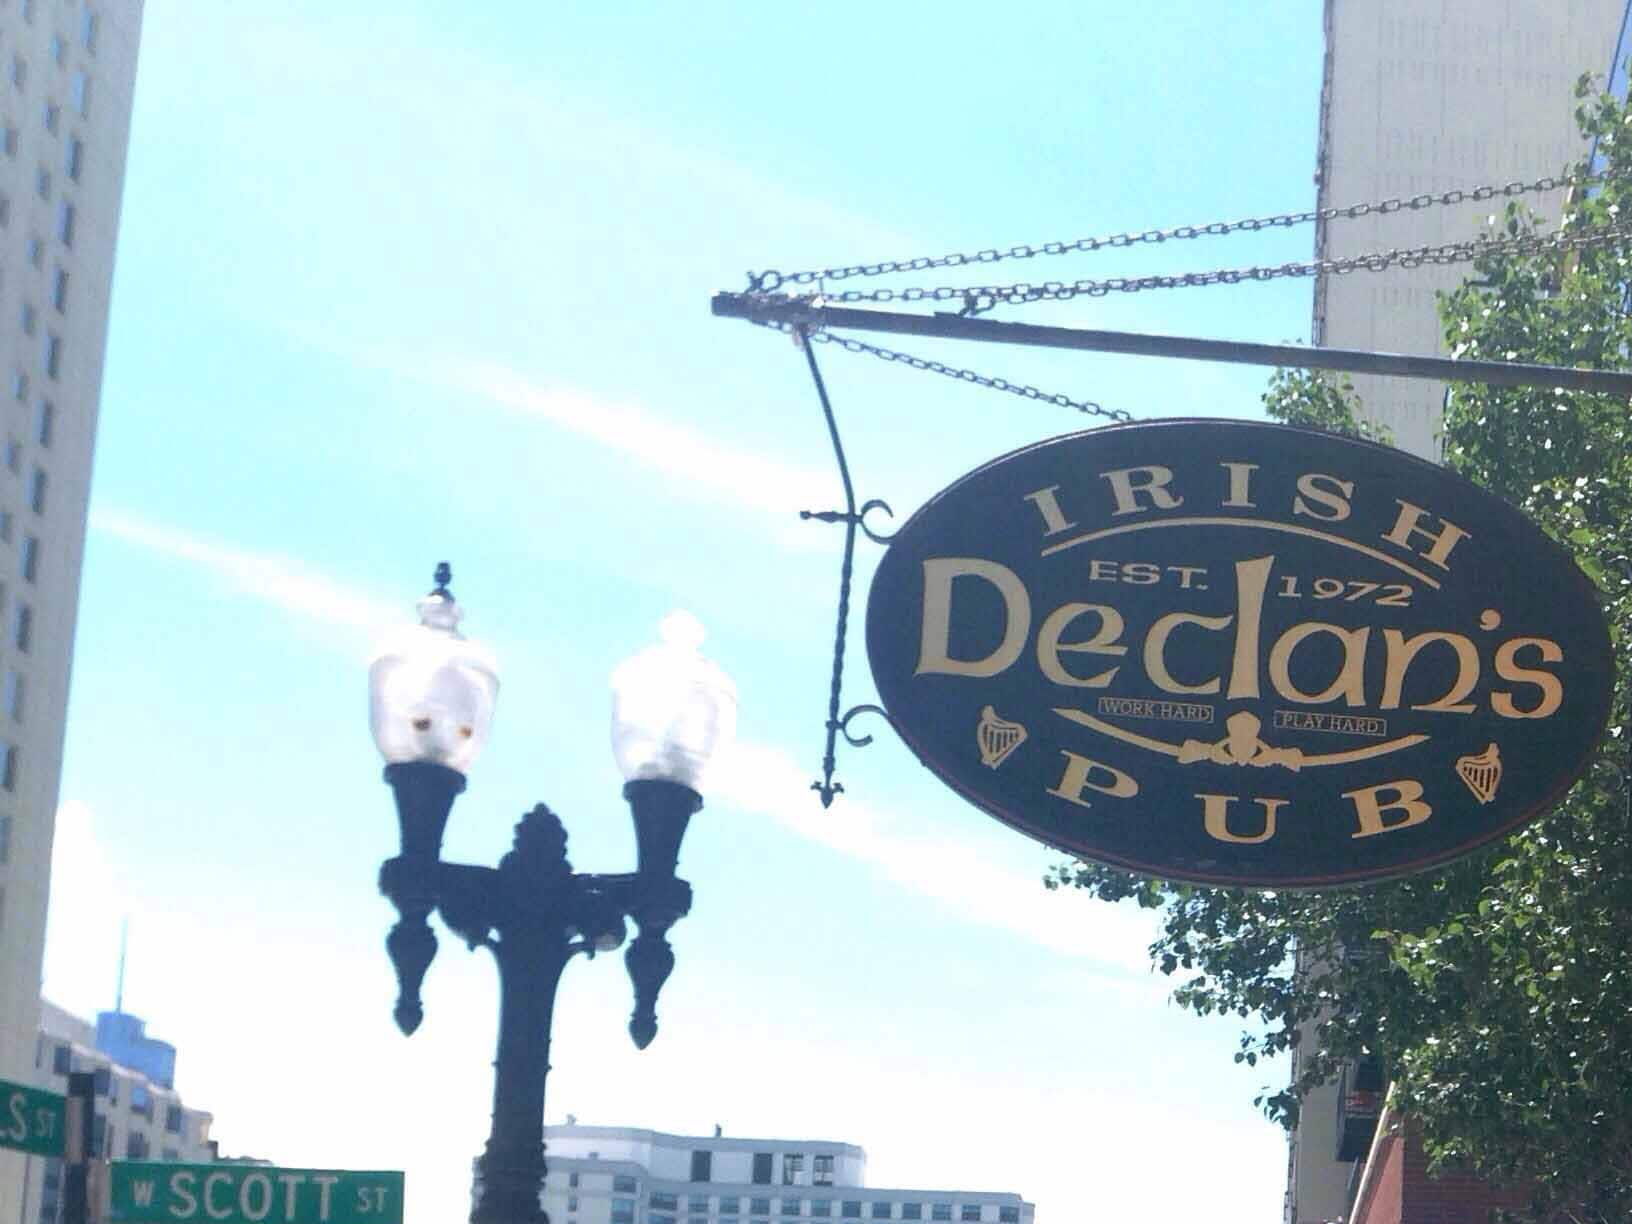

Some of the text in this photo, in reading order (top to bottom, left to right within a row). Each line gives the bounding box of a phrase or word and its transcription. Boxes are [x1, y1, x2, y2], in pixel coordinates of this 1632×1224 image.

[1024, 461, 1473, 572] IRISH
[1089, 559, 1414, 608] EST. 1972
[914, 554, 1565, 720] Declan's
[1103, 699, 1212, 721] WORK HARD
[1282, 713, 1380, 734] PLAY HARD
[1046, 749, 1435, 845] PUB
[36, 1108, 57, 1140] ST
[131, 1170, 390, 1222] W SCOTT ST
